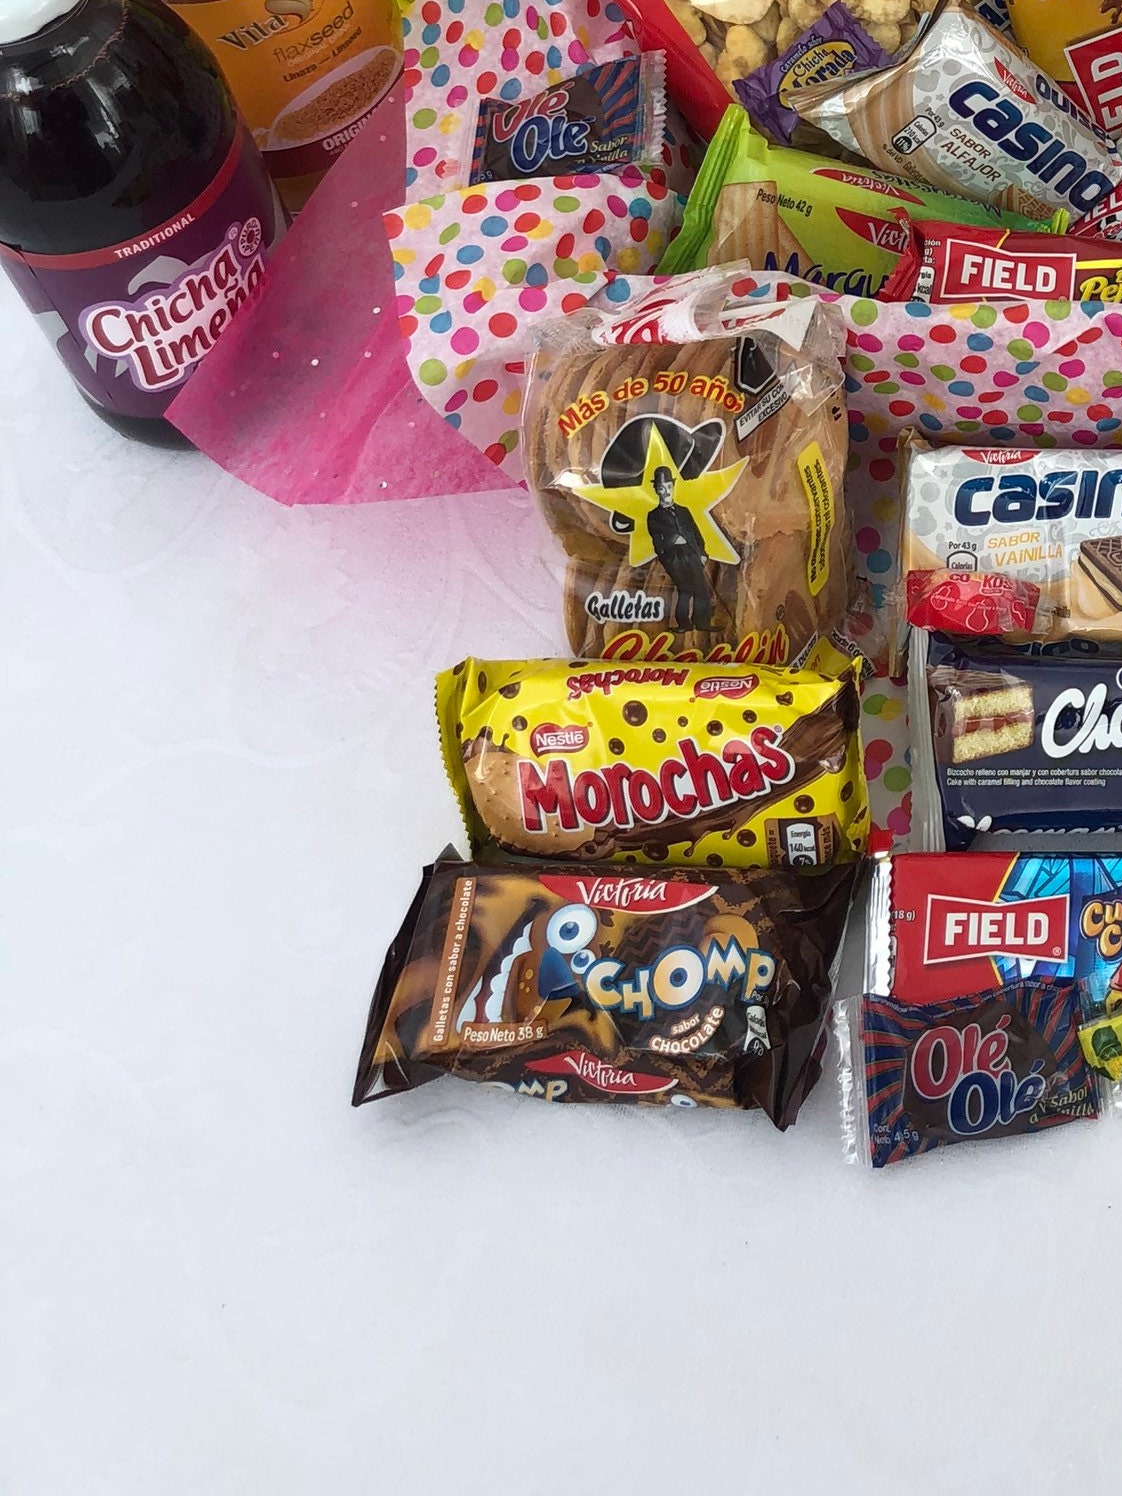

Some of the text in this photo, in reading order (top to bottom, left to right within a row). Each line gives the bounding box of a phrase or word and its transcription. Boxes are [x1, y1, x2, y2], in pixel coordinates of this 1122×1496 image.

[217, 12, 289, 51] Vita
[793, 49, 831, 78] Chicha
[511, 115, 596, 172] Olé
[949, 128, 992, 160] SABOR
[949, 81, 1113, 212] casino
[940, 140, 1001, 183] ALFAJOR
[756, 188, 806, 212] Peso Neto 42
[841, 172, 900, 196] Victoria
[114, 213, 196, 260] TRADITIONAL
[960, 254, 1057, 293] FIELD
[91, 250, 238, 354] Chicha
[557, 390, 609, 438] Más
[613, 377, 645, 402] de
[653, 372, 689, 394] 50
[981, 450, 1022, 464] Victoria
[949, 541, 971, 550] Por 43
[987, 532, 1040, 550] SABOR
[995, 544, 1064, 568] VAINILLA
[586, 593, 661, 620] Galletas
[566, 667, 690, 701] Morochas
[698, 677, 755, 693] Nestlé
[535, 731, 584, 747] Nestlé
[519, 727, 791, 832] Morochas
[789, 843, 803, 852] 140
[577, 878, 667, 905] Victoria
[945, 913, 1049, 946] FIELD
[586, 936, 776, 1021] CHOMP
[433, 996, 453, 1043] Galletas
[463, 1025, 533, 1042] Peso Neto 38
[651, 1006, 725, 1054] CHOCOLATE
[671, 1014, 701, 1036] sabor
[565, 1053, 636, 1087] Victoria
[912, 1015, 1011, 1099] Olé
[948, 1059, 1045, 1135] Olé
